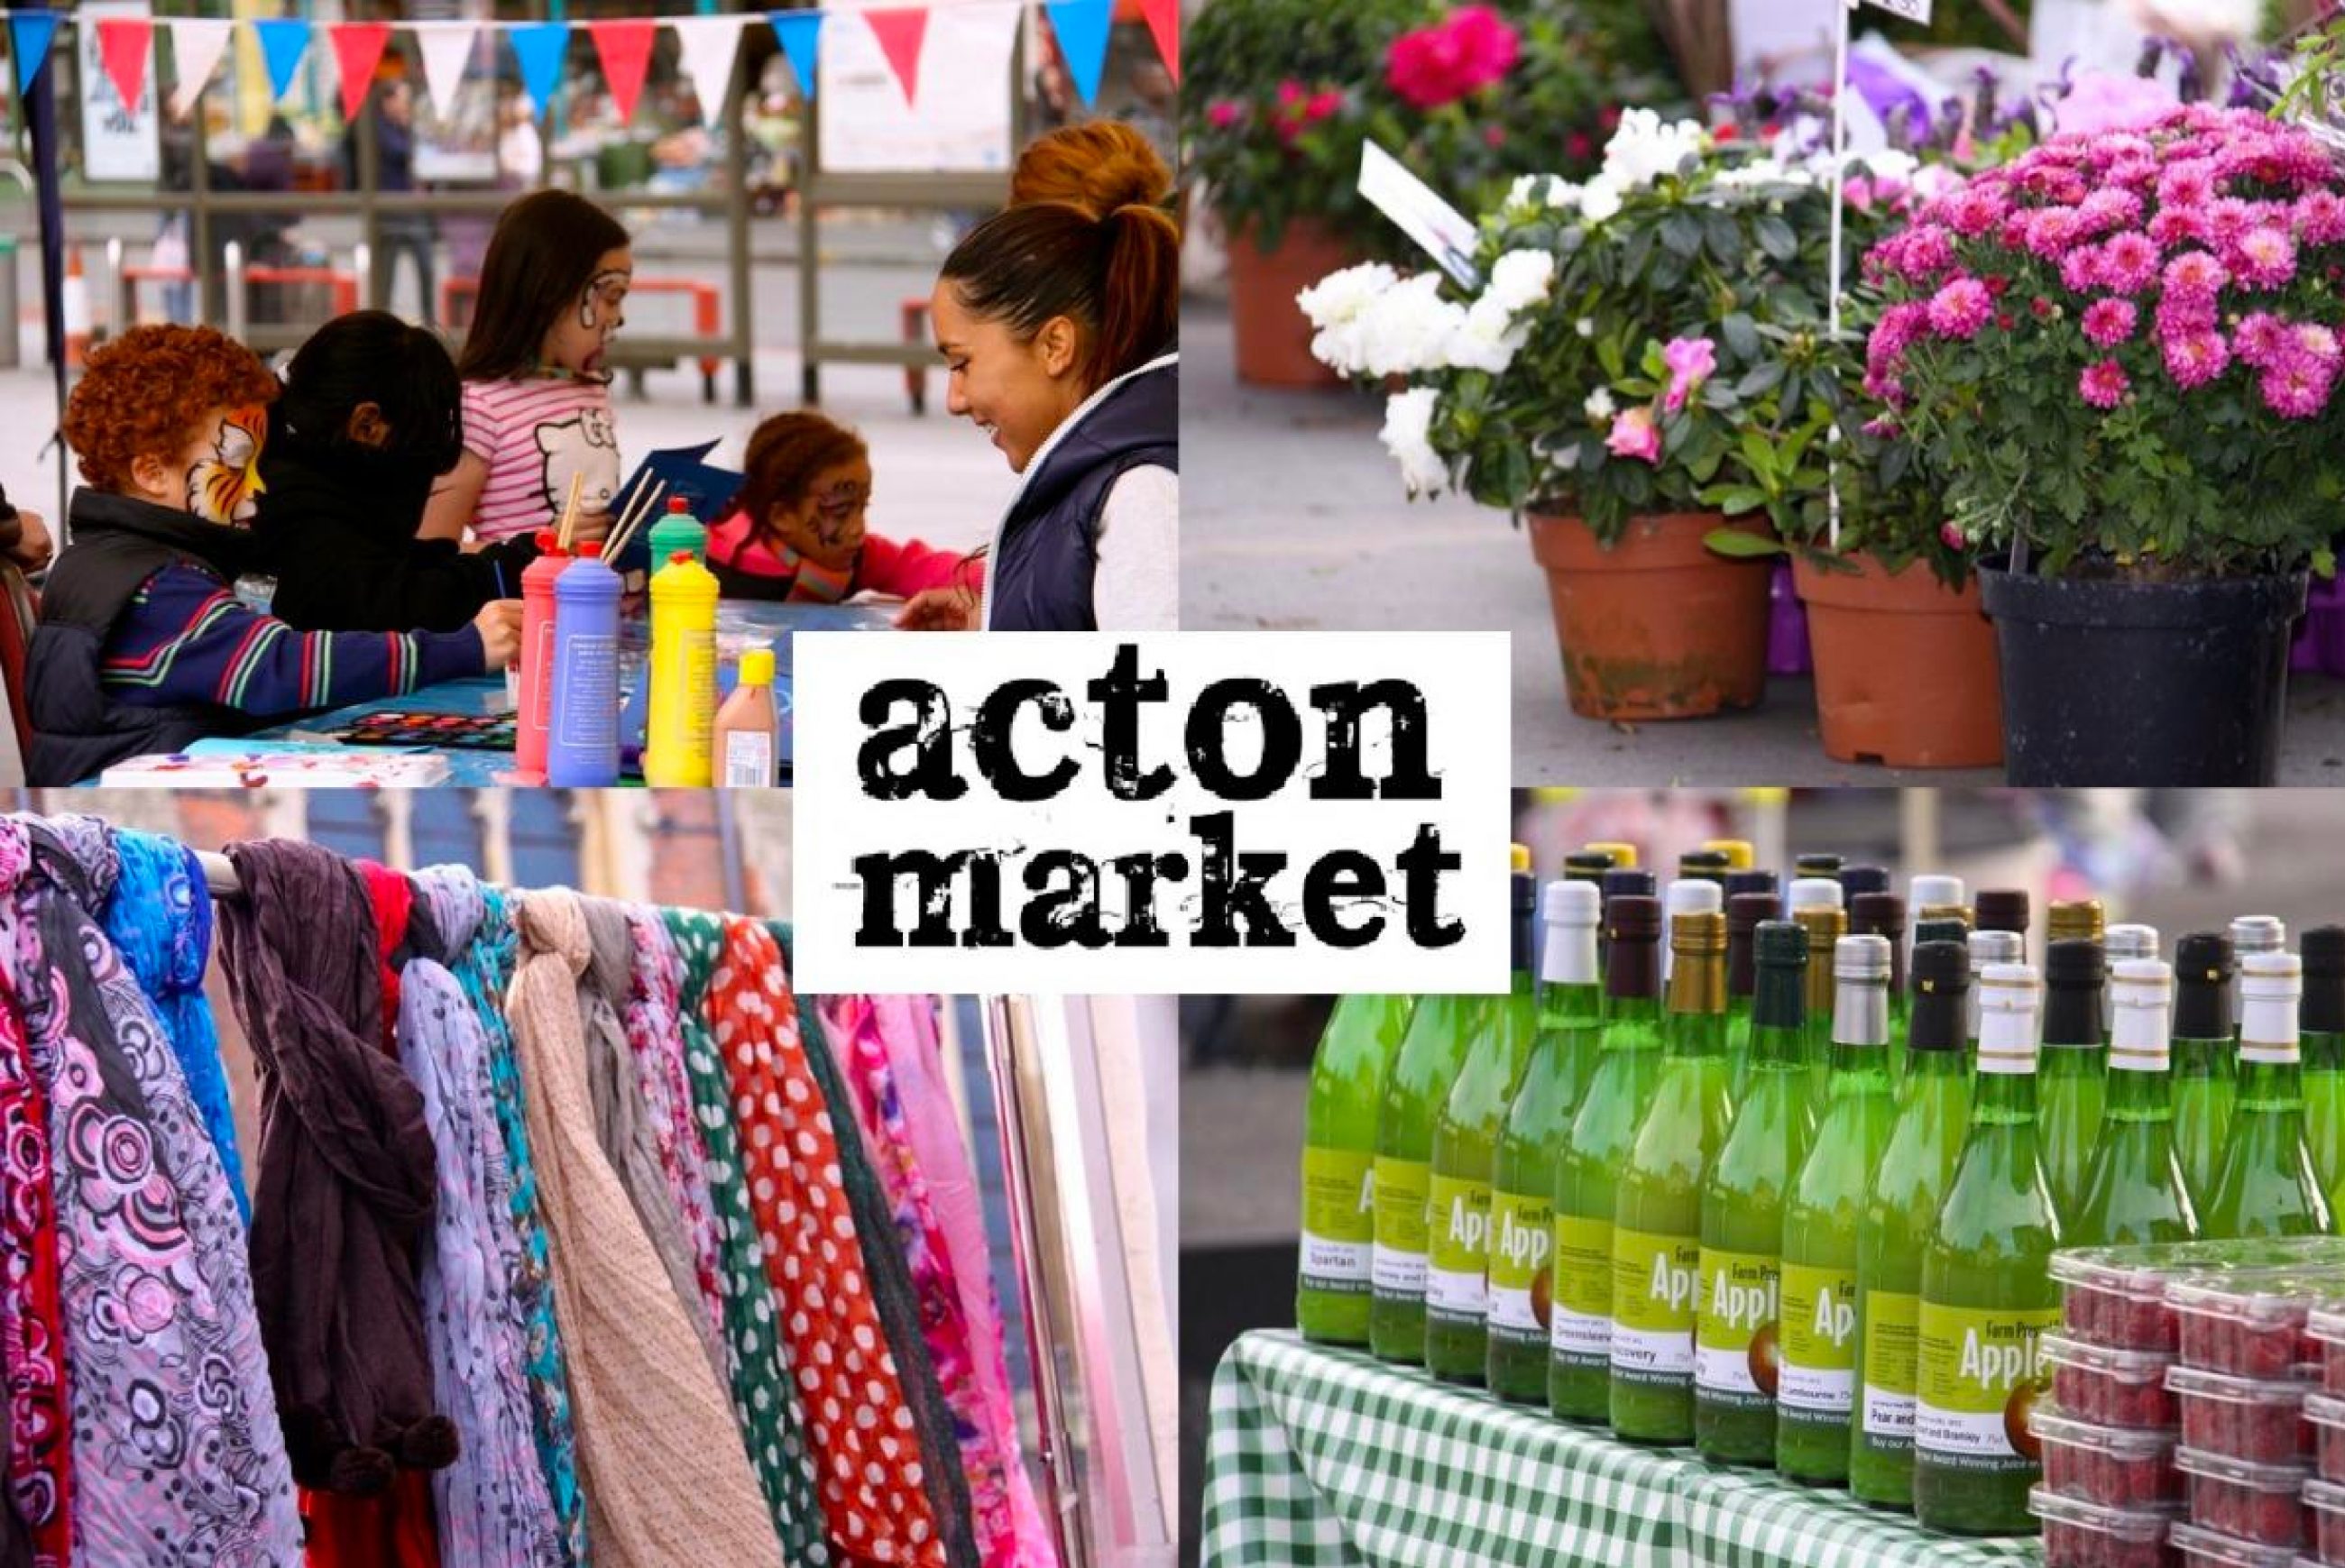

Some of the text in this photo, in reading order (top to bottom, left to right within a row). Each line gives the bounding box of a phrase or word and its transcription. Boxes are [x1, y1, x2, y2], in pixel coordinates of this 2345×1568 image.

[1986, 1319, 2015, 1338] Farm
[1959, 1327, 2046, 1390] Apple
[1896, 1414, 1915, 1426] and
